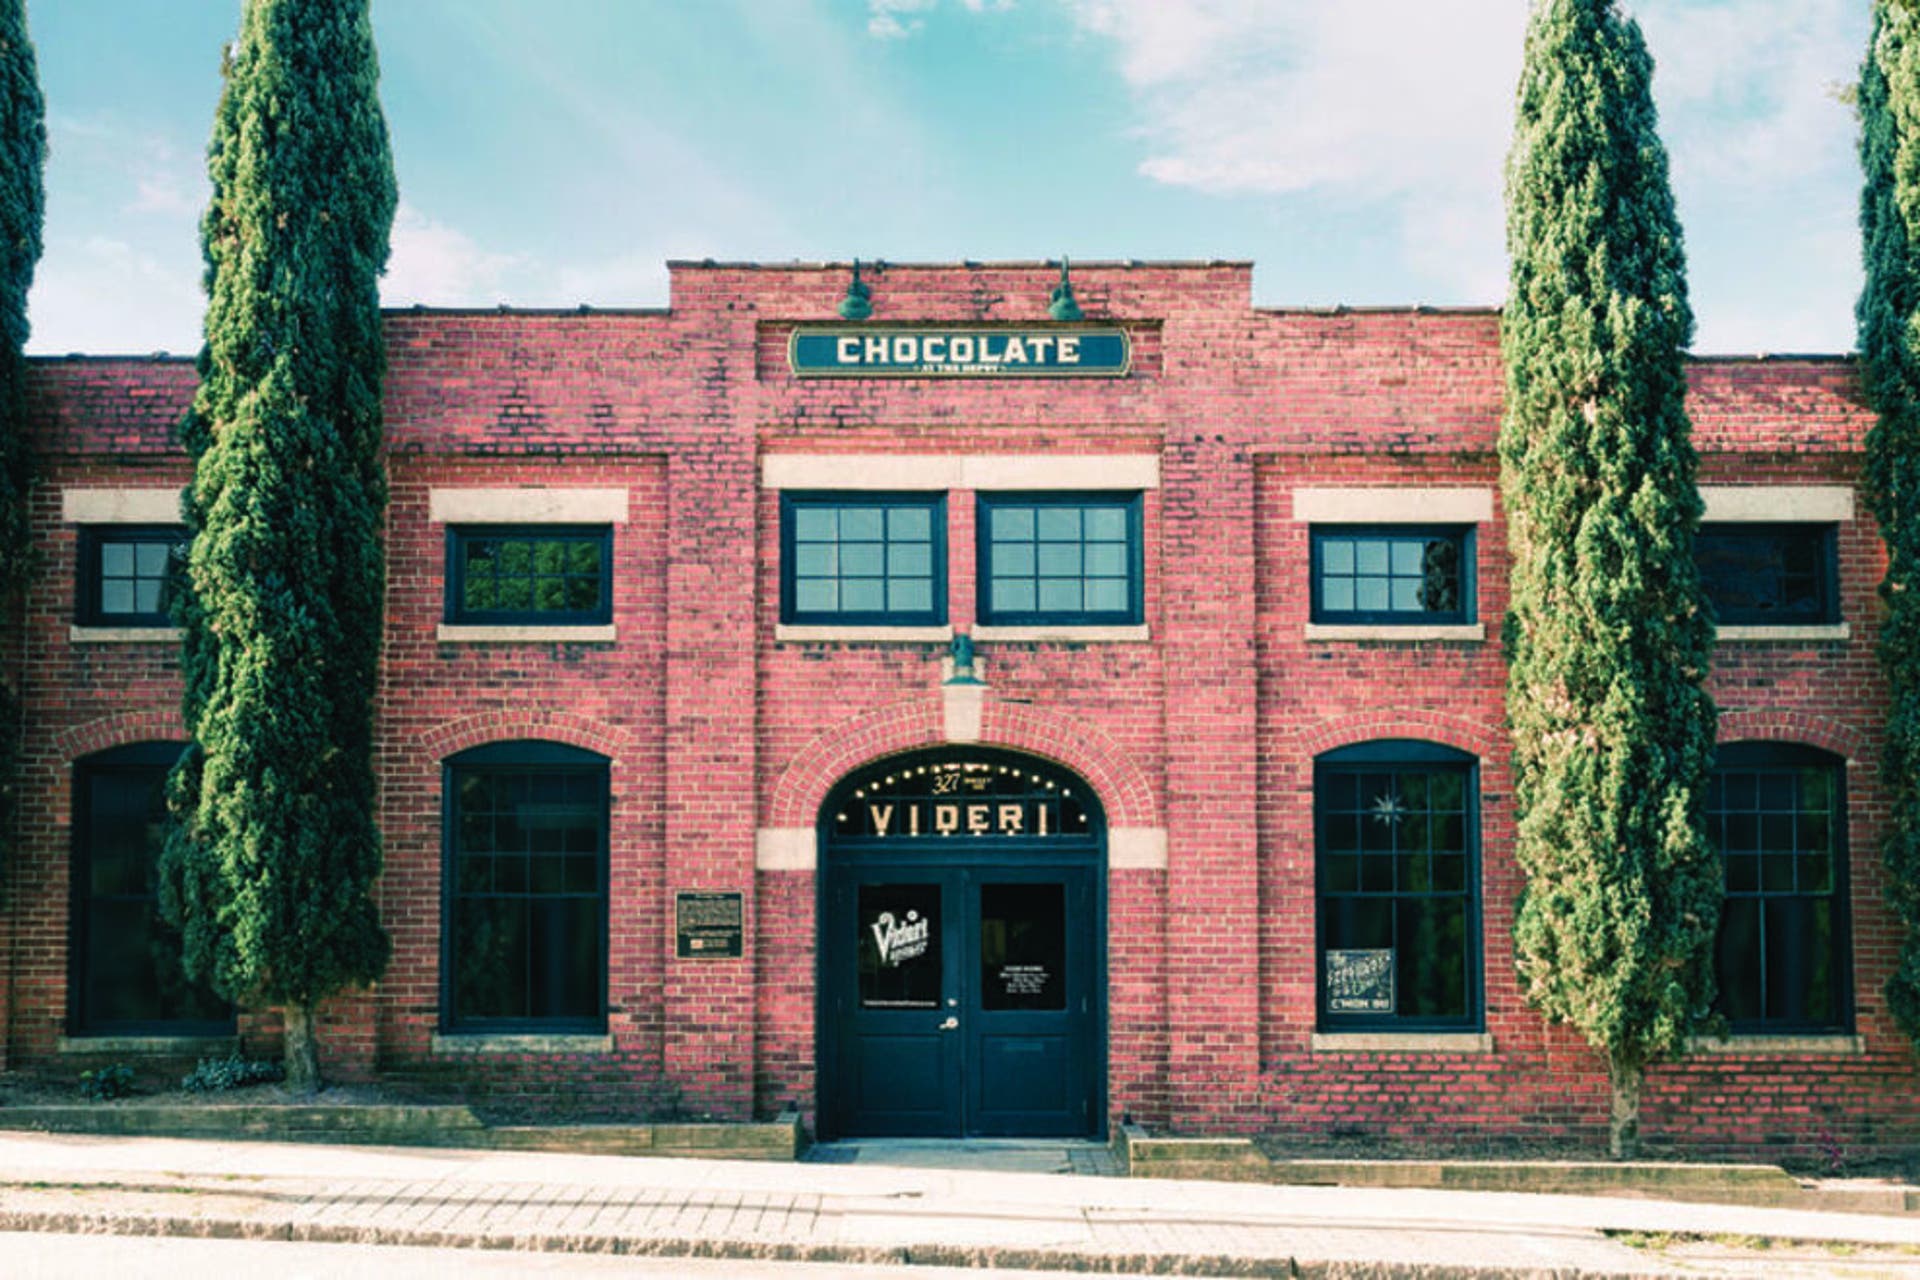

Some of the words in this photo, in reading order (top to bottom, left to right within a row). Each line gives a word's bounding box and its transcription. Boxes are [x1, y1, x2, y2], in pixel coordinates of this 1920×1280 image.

[836, 336, 1080, 364] CHOCOLATE
[931, 772, 961, 795] 327
[870, 804, 1048, 835] VIDERI
